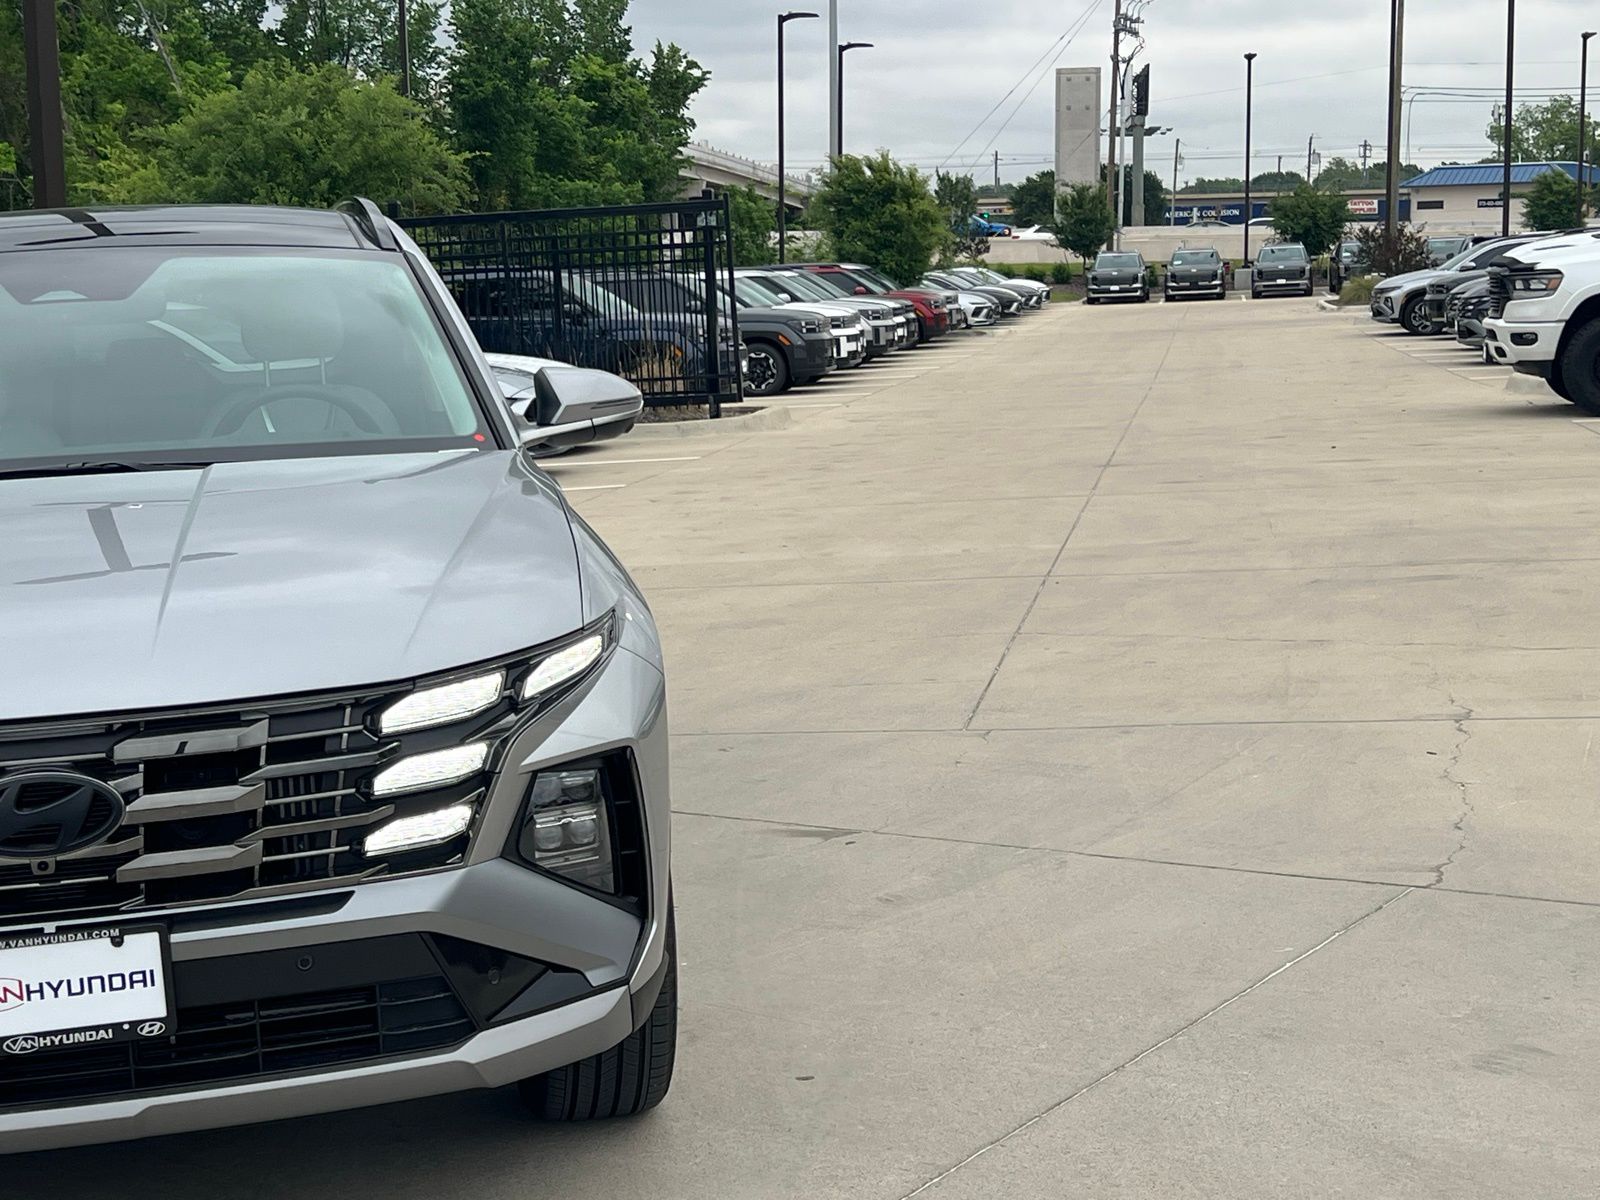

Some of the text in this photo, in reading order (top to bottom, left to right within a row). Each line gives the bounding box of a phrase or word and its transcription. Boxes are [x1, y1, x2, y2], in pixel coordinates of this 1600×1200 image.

[1202, 209, 1240, 217] COLISION
[25, 969, 155, 1001] HYUNDAI
[39, 1029, 113, 1047] HYUNDAI
